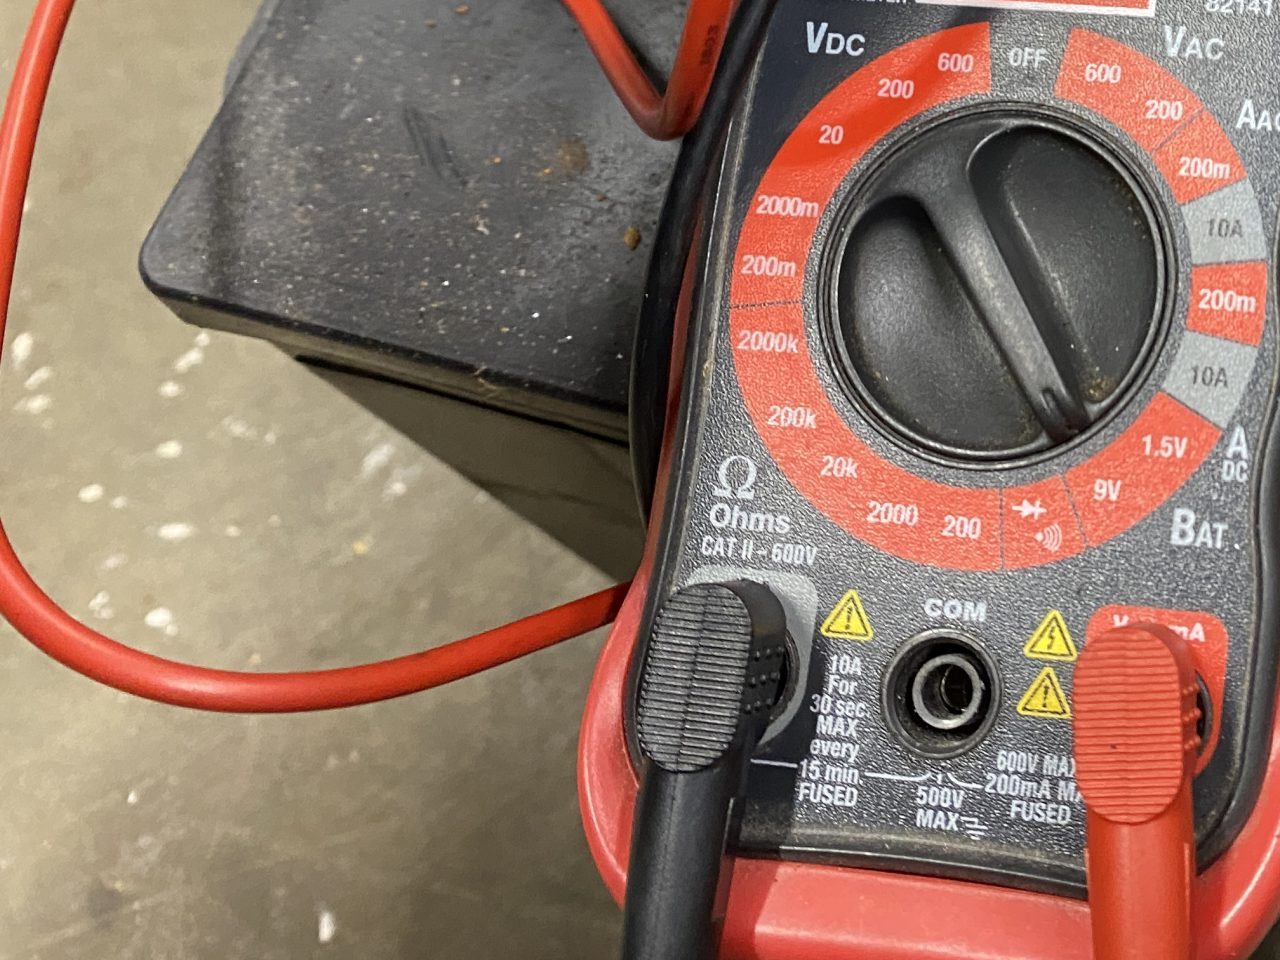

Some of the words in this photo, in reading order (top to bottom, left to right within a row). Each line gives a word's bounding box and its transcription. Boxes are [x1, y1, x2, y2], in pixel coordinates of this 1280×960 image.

[938, 53, 973, 73] 600
[1008, 47, 1050, 68] OFF
[1085, 63, 1121, 84] 600
[877, 79, 914, 99] 200
[1145, 100, 1183, 120] 200
[818, 125, 844, 144] 20
[1179, 157, 1231, 179] 200m
[756, 195, 819, 218] 2000m
[1207, 218, 1243, 238] 10A
[741, 255, 796, 277] 200m
[1198, 288, 1256, 312] 200m
[737, 330, 798, 353] 2000k
[1191, 367, 1228, 388] 10A
[767, 405, 816, 430] 200k
[1142, 435, 1188, 458] 1.5V
[1226, 424, 1248, 459] A
[820, 455, 858, 479] 20k
[1222, 460, 1248, 483] DC
[1093, 479, 1121, 501] 9V
[710, 503, 791, 534] Ohms
[866, 501, 919, 526] 2000
[941, 515, 981, 540] 200
[702, 535, 737, 558] CAT
[772, 543, 818, 566] 600V
[924, 599, 987, 622] COM
[830, 655, 862, 675] 10A
[829, 675, 858, 695] For
[810, 694, 831, 713] 30
[816, 715, 858, 738] MAX
[810, 740, 859, 763] every
[997, 750, 1039, 773] 600V
[800, 759, 820, 779] 15
[799, 784, 858, 807] FUSED
[916, 786, 965, 808] 500V
[985, 773, 1051, 800] 200mA
[916, 809, 961, 830] MAX
[1010, 800, 1071, 825] FUSED
